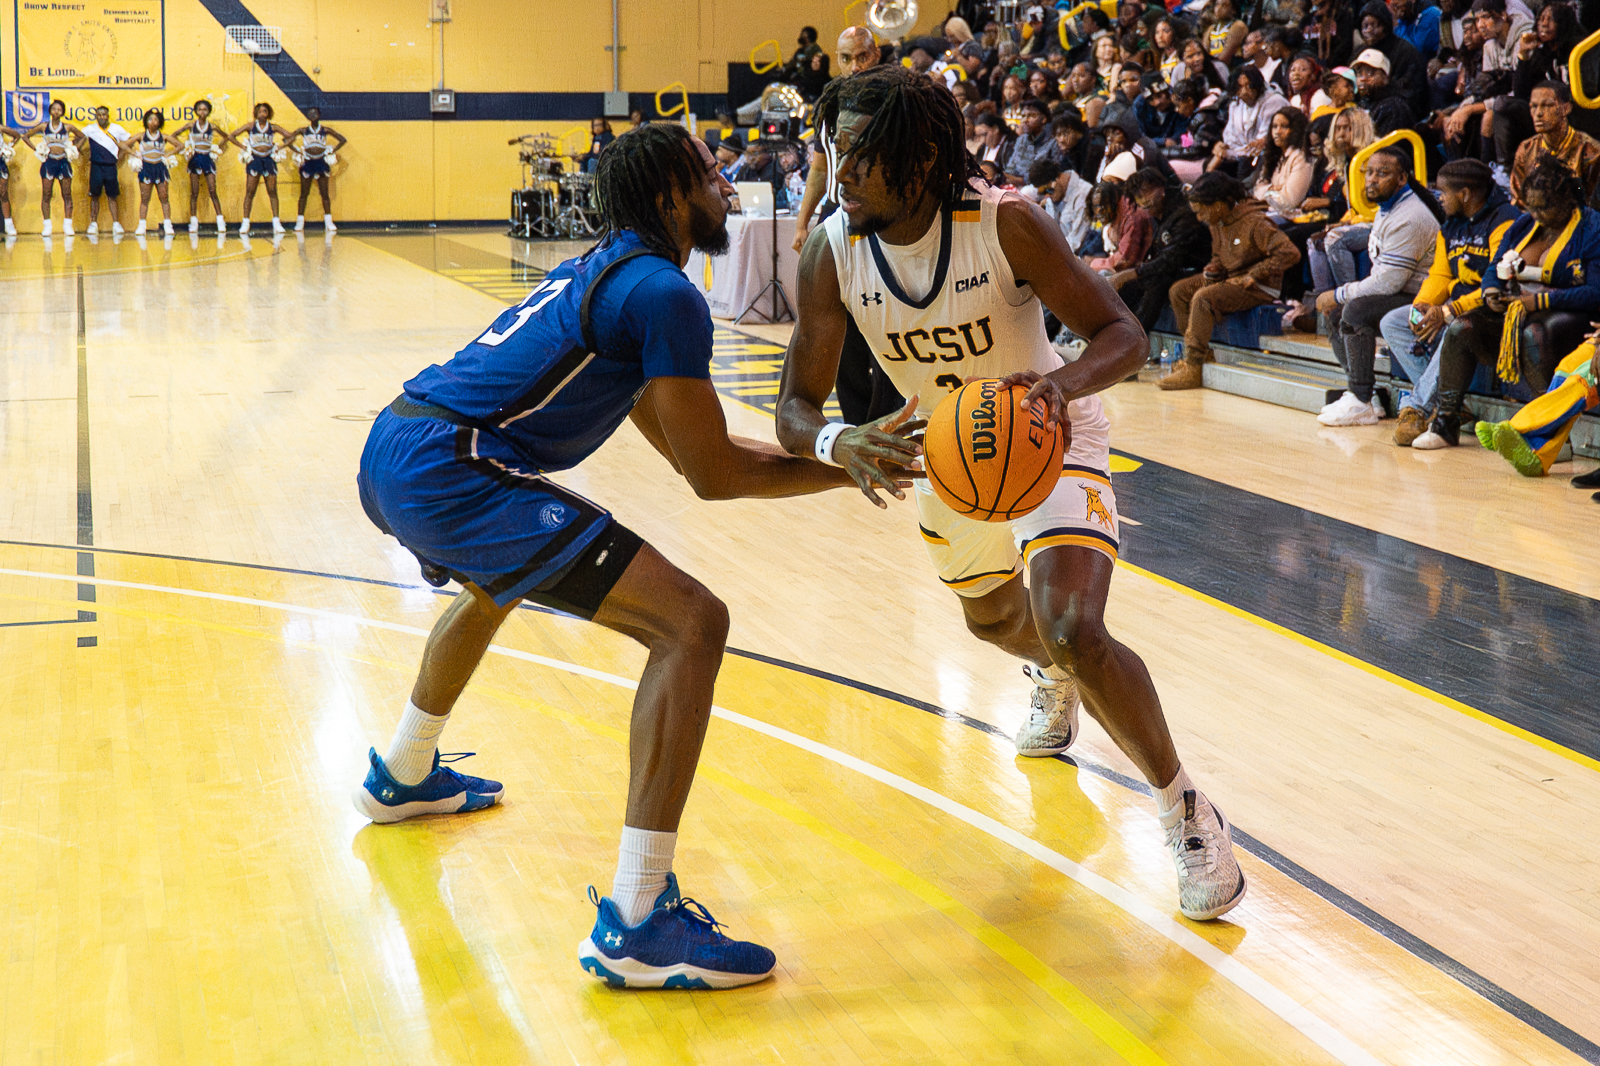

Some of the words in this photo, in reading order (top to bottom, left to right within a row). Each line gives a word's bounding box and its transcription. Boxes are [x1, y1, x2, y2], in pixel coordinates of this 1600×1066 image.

[115, 106, 143, 121] 100
[955, 272, 989, 293] CIAA
[882, 315, 995, 364] JCSU
[971, 381, 998, 463] Wilson
